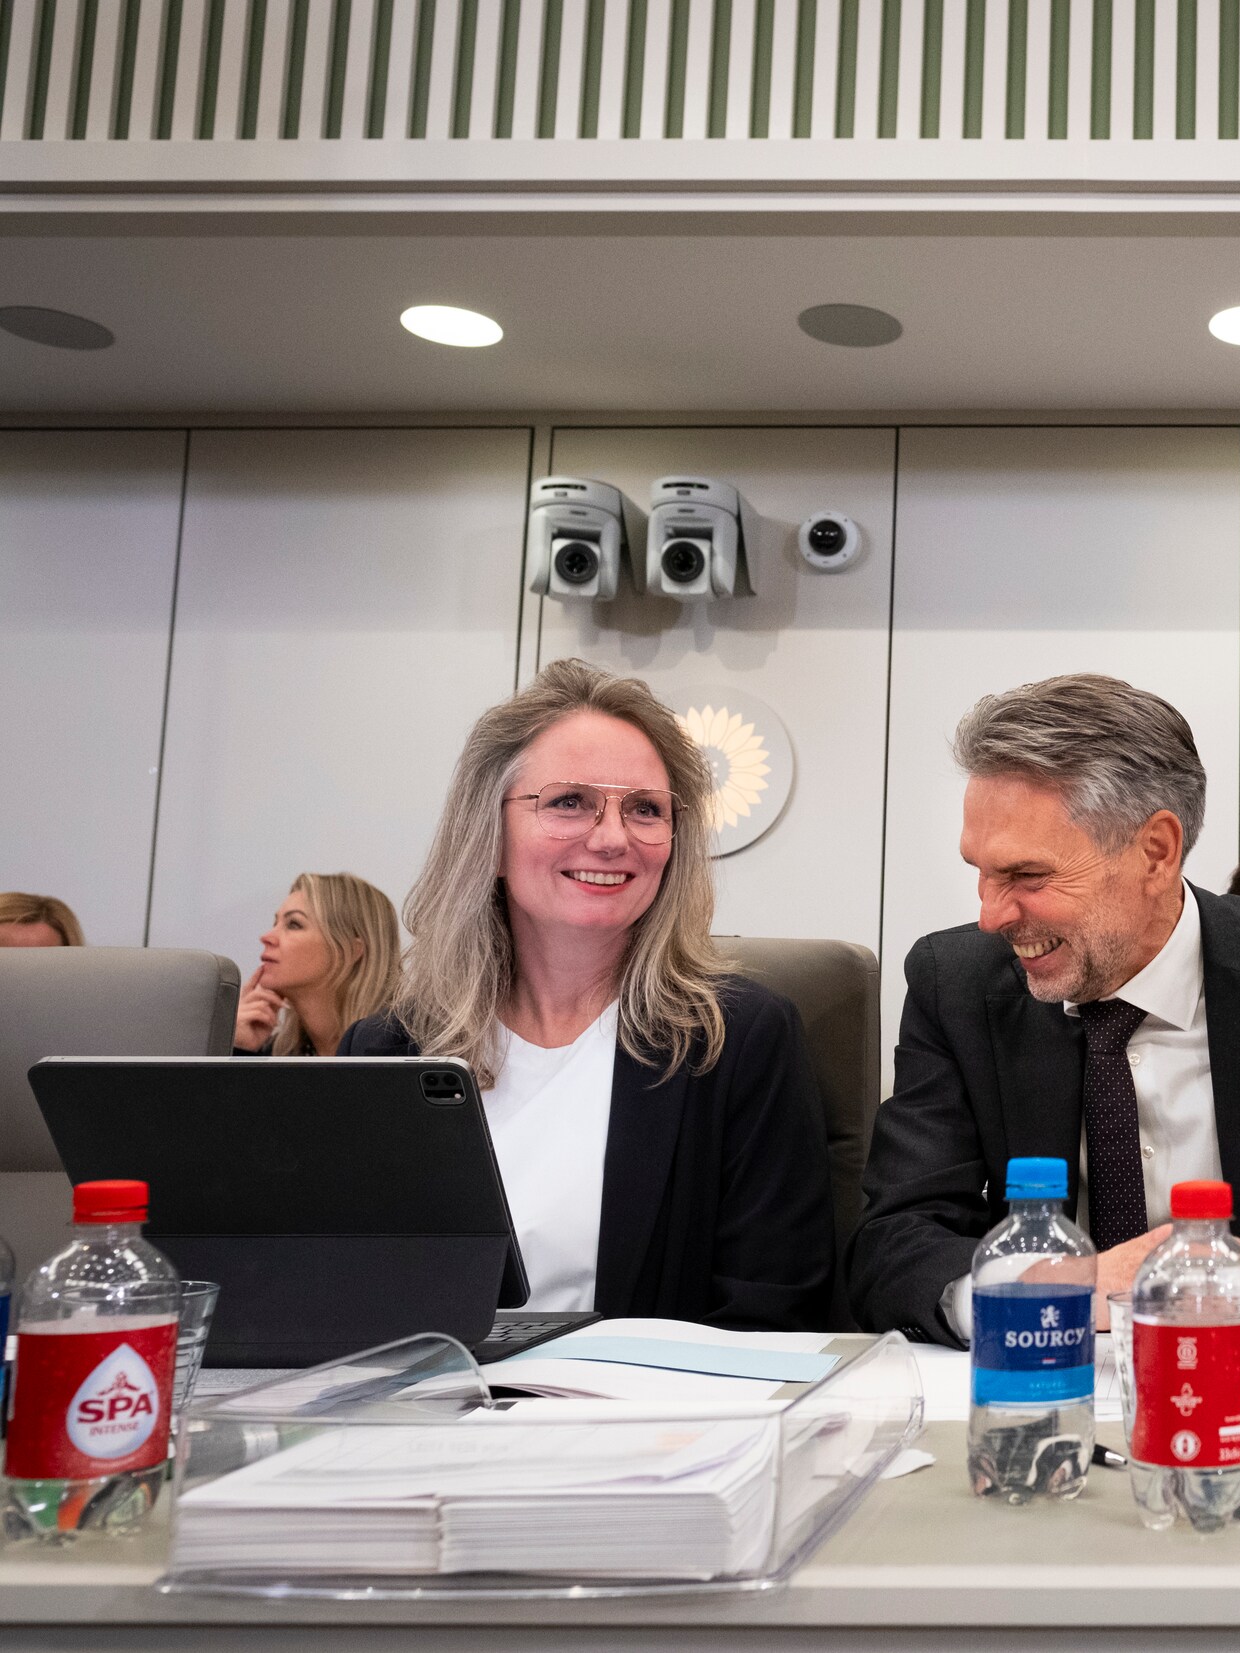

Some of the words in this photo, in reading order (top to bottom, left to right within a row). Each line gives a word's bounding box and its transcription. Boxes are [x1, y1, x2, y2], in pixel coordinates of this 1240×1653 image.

[1004, 1327, 1086, 1348] SOURCY
[78, 1393, 153, 1423] SPA
[90, 1422, 139, 1435] INTENSE
